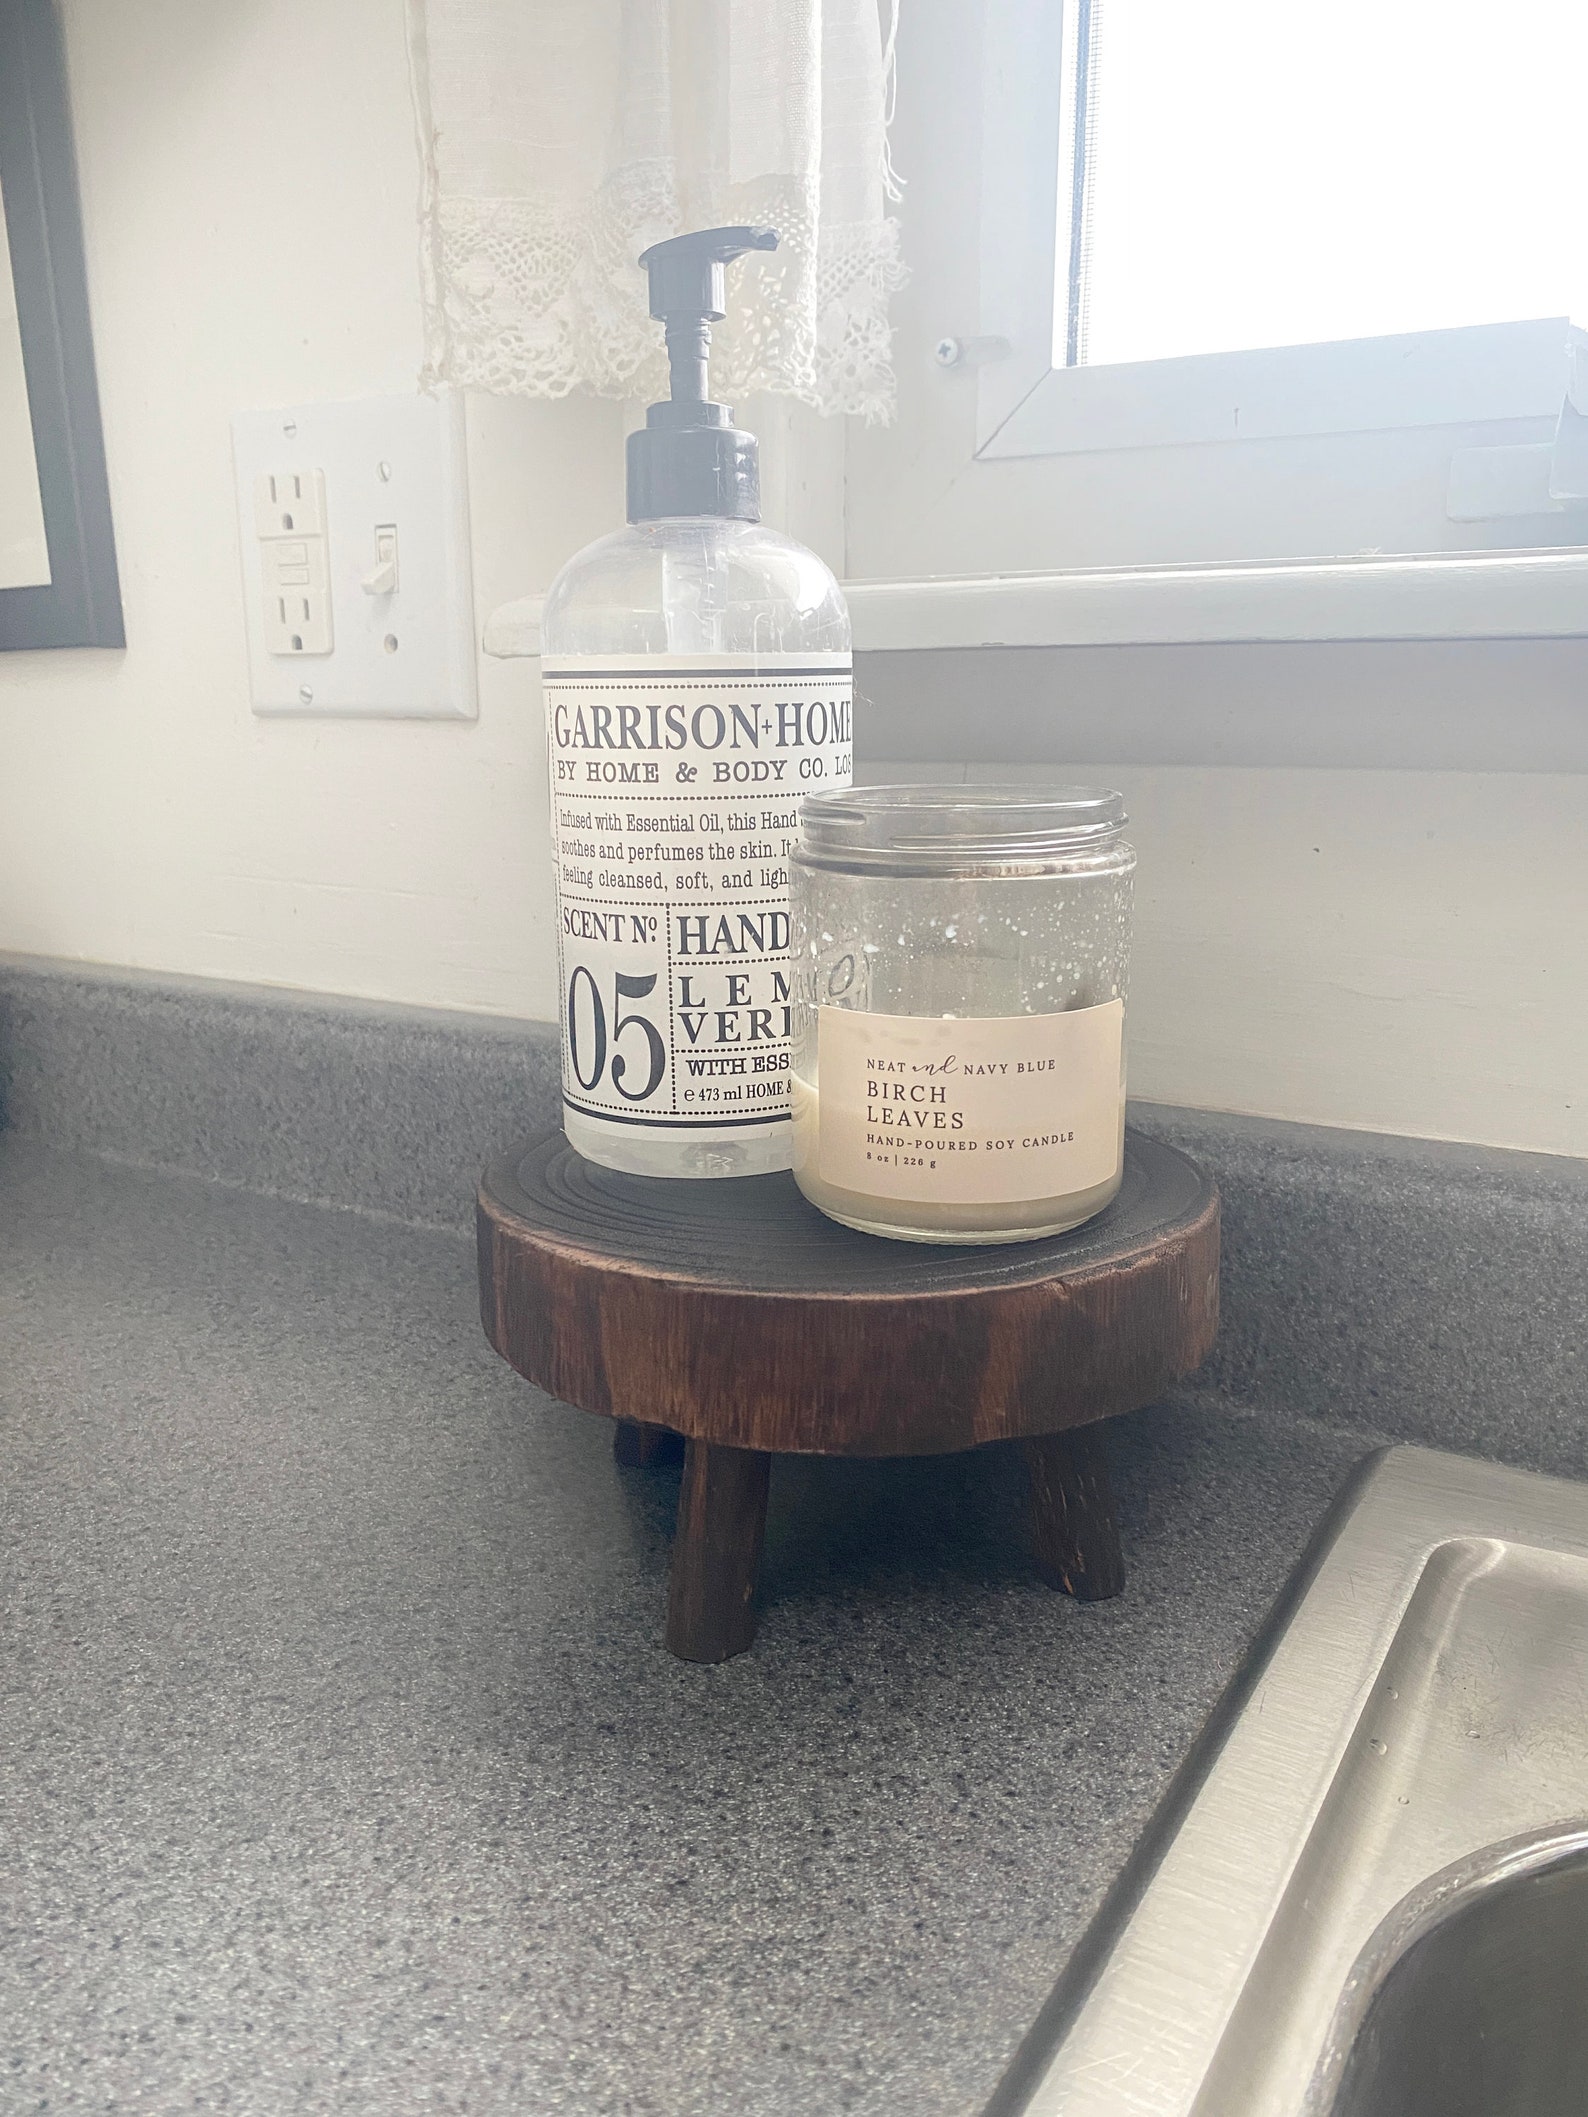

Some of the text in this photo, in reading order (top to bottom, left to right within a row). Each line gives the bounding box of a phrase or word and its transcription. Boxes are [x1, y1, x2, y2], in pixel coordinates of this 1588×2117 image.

[557, 757, 577, 782] BY
[586, 760, 660, 784] HOME
[674, 758, 699, 784] &
[712, 758, 789, 784] BODY
[799, 756, 829, 780] CO.
[559, 808, 798, 836] Infused with Essential Oil, this Hand
[561, 838, 792, 865] soothes and perfumes the skin. It
[562, 864, 594, 890] feeling
[598, 868, 669, 891] cleansed,
[675, 872, 714, 891] soft,
[721, 870, 753, 889] and
[563, 907, 625, 942] SCENT
[677, 911, 790, 955] HAND
[568, 965, 666, 1101] 05
[685, 1052, 792, 1077] WITH ESS
[866, 1055, 1057, 1076] NEAT and NAVY BLUE
[698, 1087, 720, 1102] 473
[722, 1086, 743, 1100] ml
[745, 1081, 785, 1099] HOME
[867, 1081, 947, 1103] BIRCH
[867, 1106, 964, 1130] LEAVES
[866, 1131, 1075, 1152] HAND-POURED SOY CANDLE
[866, 1152, 872, 1160] 8
[876, 1155, 889, 1163] oz
[903, 1156, 924, 1167] 226
[929, 1160, 937, 1170] g
